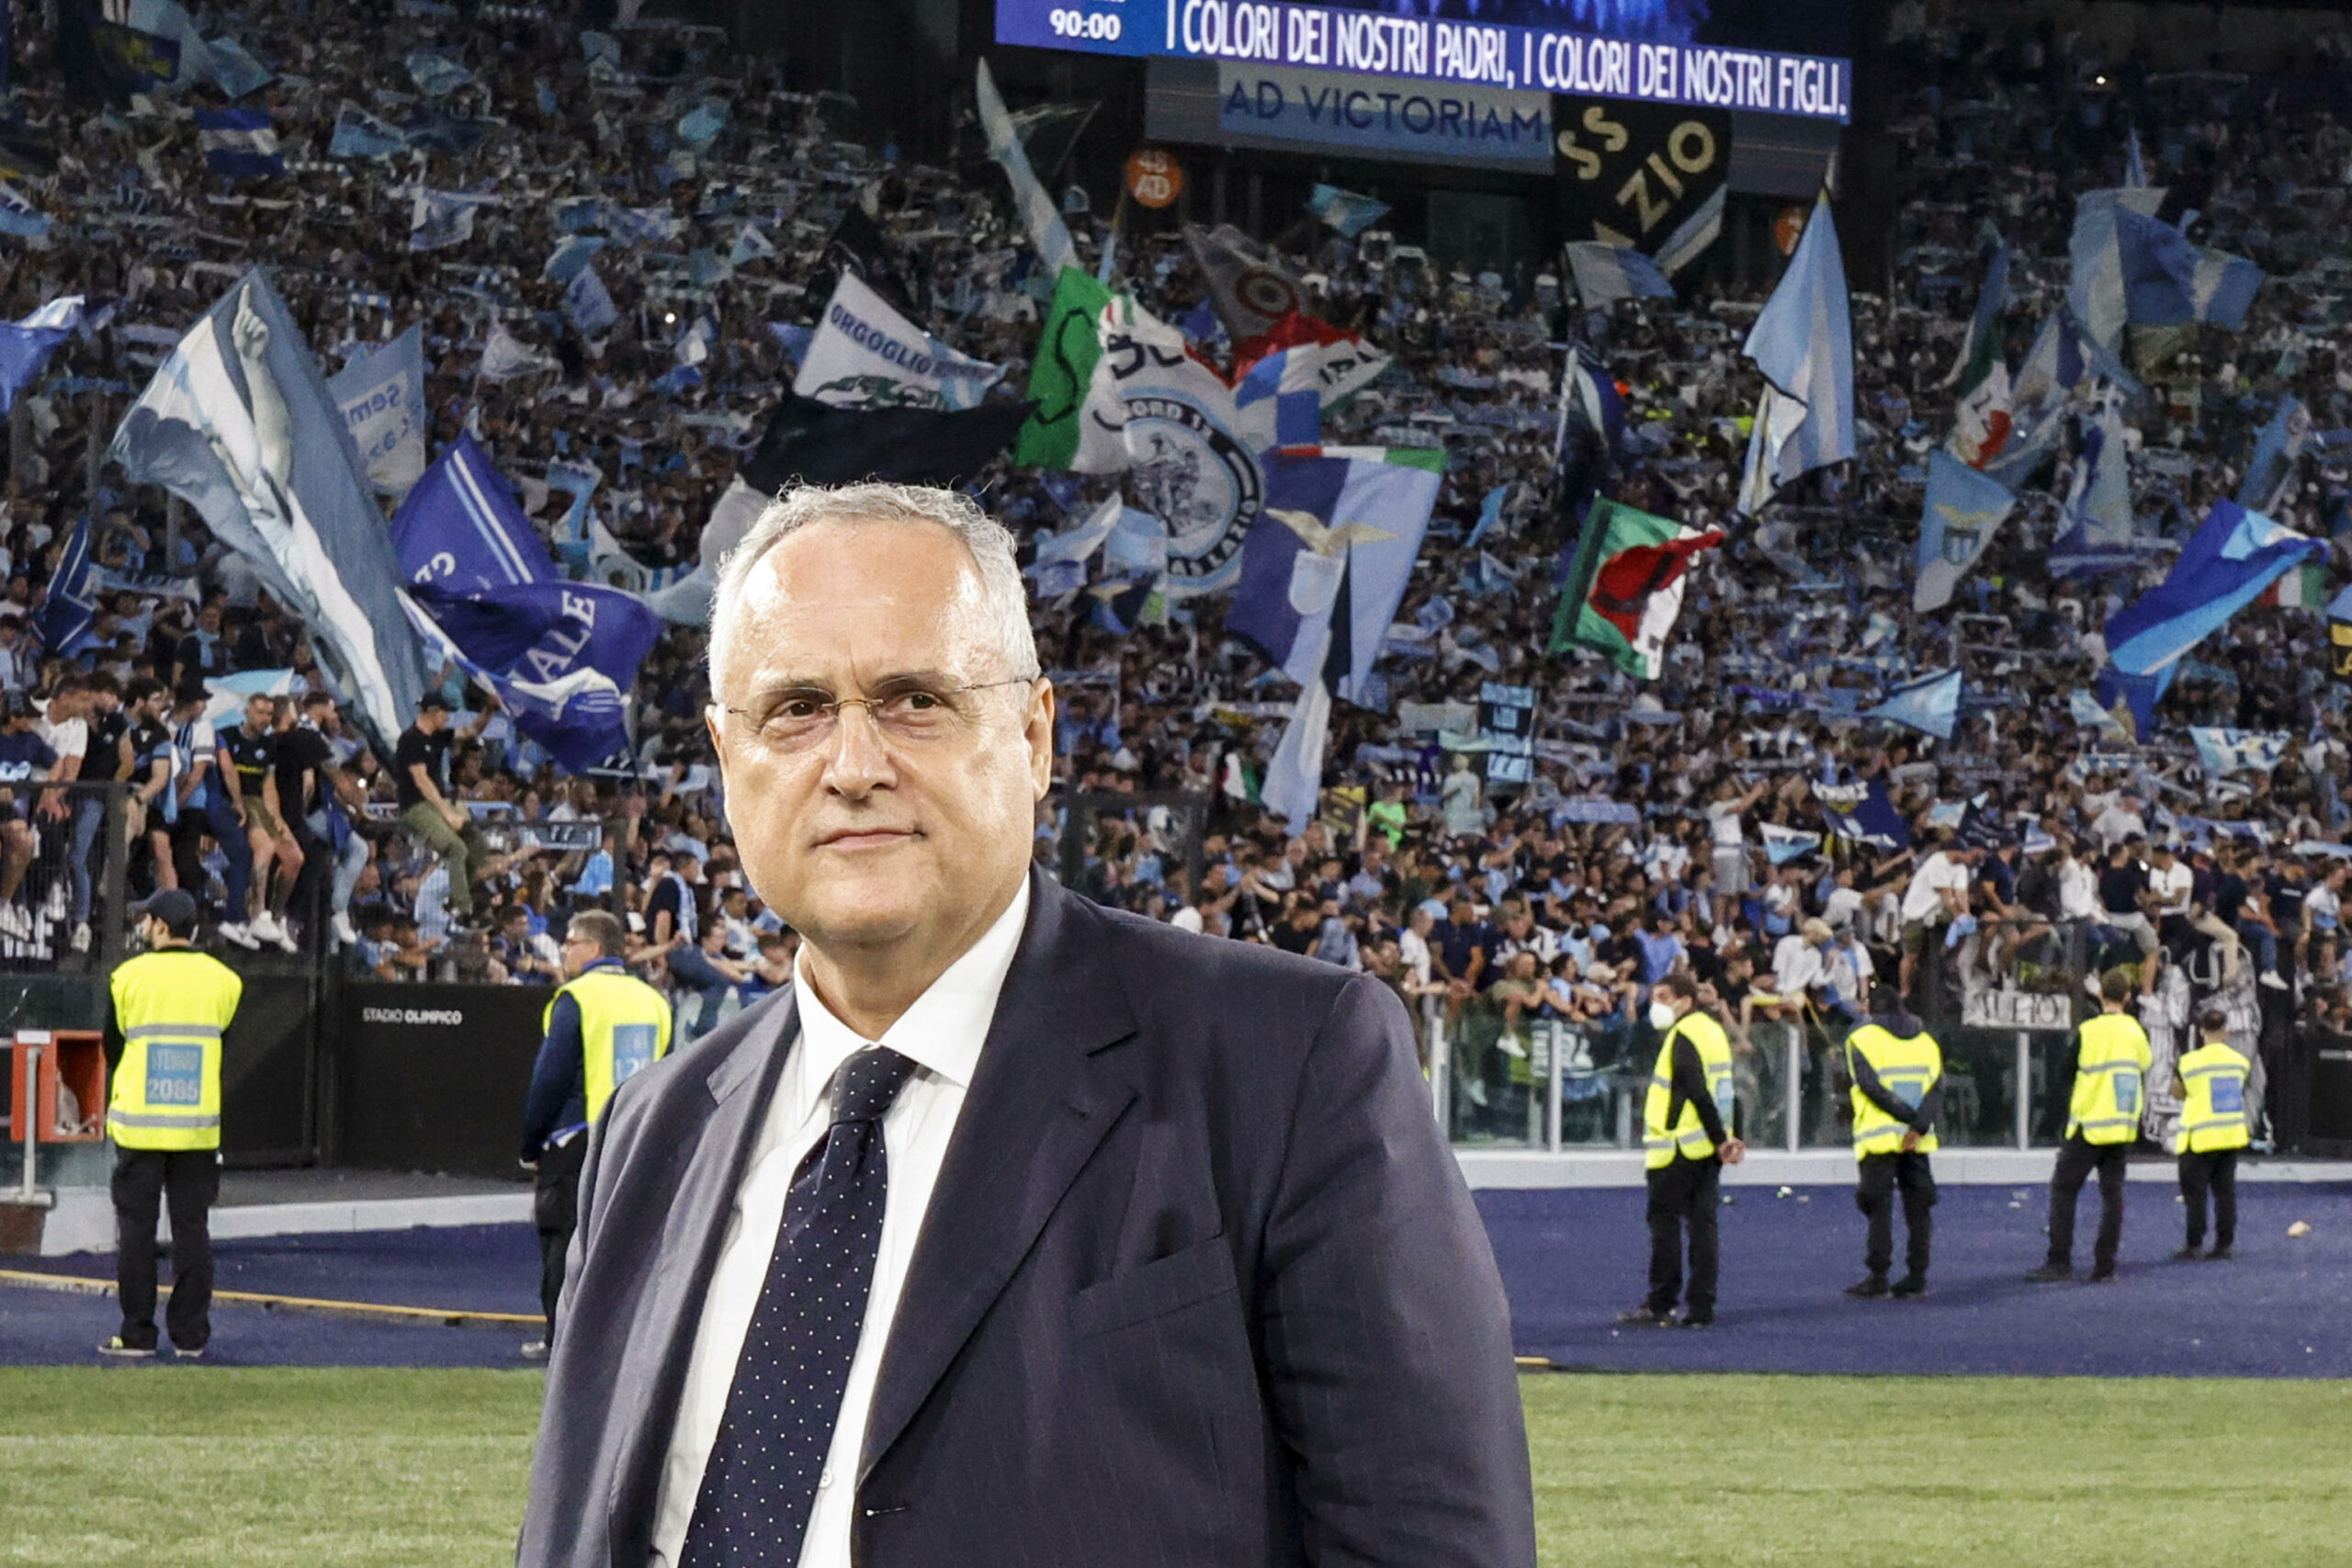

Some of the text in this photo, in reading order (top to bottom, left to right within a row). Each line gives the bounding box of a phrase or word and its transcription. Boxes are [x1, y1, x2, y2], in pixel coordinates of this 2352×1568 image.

[1049, 9, 1122, 40] 90:00
[1166, 0, 1848, 116] I COLORI DEI NOSTRI PADRI, I COLORI DEI NOSTRI FIGLI.
[1225, 80, 1544, 142] AD VICTORIAM
[1557, 106, 1629, 181] SS
[831, 304, 933, 374] ORGOGLIO
[1126, 399, 1182, 422] ORD
[363, 1007, 463, 1025] STADIO OLIMPICO
